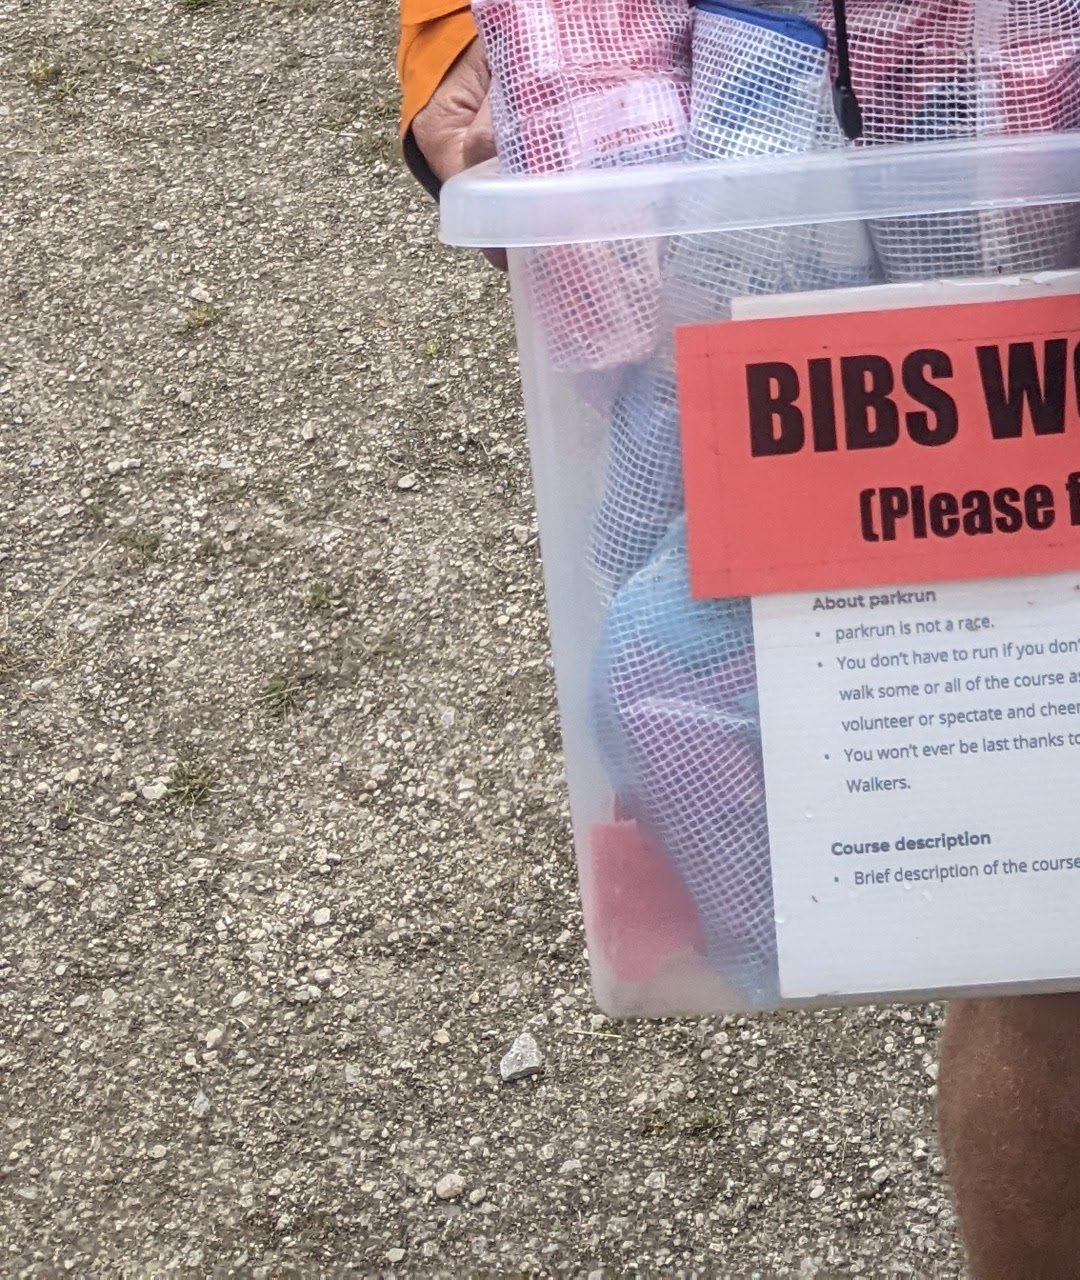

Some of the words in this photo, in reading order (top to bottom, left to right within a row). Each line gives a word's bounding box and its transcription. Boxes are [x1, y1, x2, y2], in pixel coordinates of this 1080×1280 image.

[745, 348, 959, 458] BIBS
[859, 480, 1055, 543] (Please
[812, 594, 866, 612] About
[868, 590, 937, 610] parkrun
[835, 623, 896, 644] parkrun
[899, 620, 912, 636] is
[915, 619, 942, 634] not
[944, 619, 954, 632] a
[957, 616, 995, 632] race.
[836, 655, 866, 671] You
[912, 650, 949, 665] have
[951, 648, 969, 662] to
[972, 646, 999, 660] run
[1002, 641, 1014, 658] if
[1015, 643, 1045, 661] you
[839, 684, 875, 702] walk
[877, 684, 920, 699] some
[923, 682, 941, 695] or
[944, 677, 962, 694] all
[965, 675, 982, 692] of
[984, 674, 1010, 691] the
[1013, 672, 1065, 688] course
[840, 715, 915, 733] volunteer
[918, 714, 935, 727] or
[938, 708, 1003, 729] spectate
[1006, 702, 1036, 720] and
[843, 748, 874, 763] You
[922, 743, 956, 757] ever
[958, 739, 979, 755] be
[982, 737, 1010, 753] last
[1012, 732, 1065, 750] thanks
[845, 776, 912, 794] Walkers.
[830, 841, 891, 857] Course
[894, 830, 992, 852] description
[854, 867, 891, 886] Brief
[893, 863, 979, 883] description
[982, 859, 1000, 876] of
[1001, 858, 1028, 875] the
